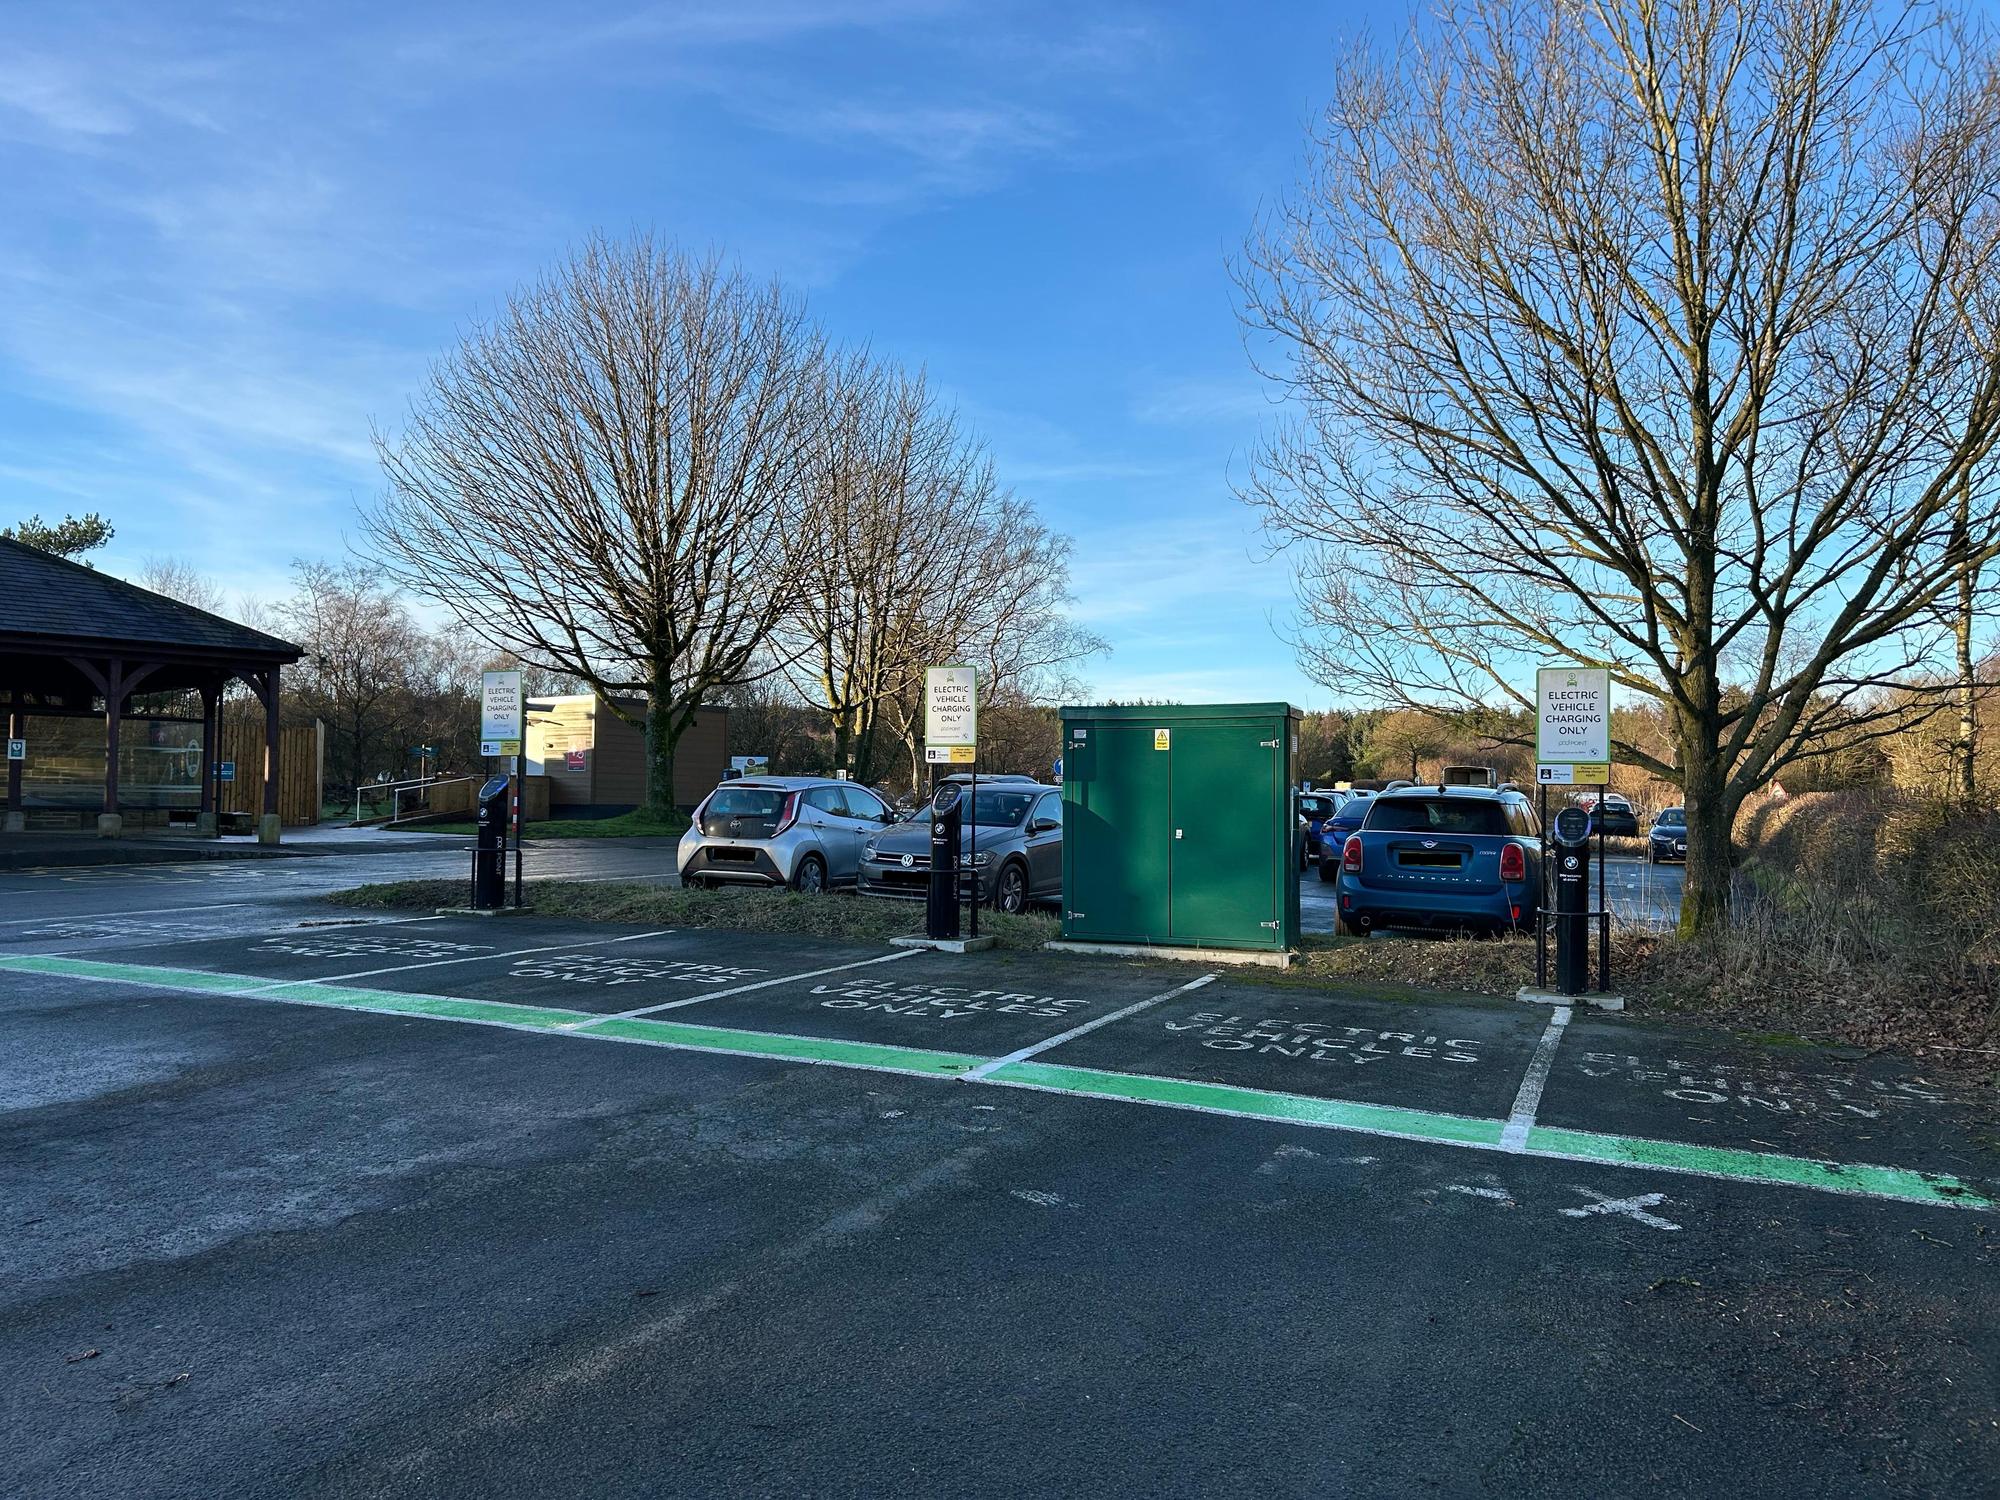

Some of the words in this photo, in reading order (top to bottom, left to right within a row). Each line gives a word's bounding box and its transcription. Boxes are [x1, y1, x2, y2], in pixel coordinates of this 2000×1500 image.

[934, 685, 969, 693] ELECTRIC
[1548, 691, 1598, 700] ELECTRIC
[1551, 703, 1595, 711] VEHICLE
[1545, 715, 1601, 723] CHARGING
[1559, 726, 1588, 735] ONLY
[262, 937, 455, 958] VCLES
[311, 934, 496, 951] CTRIC
[512, 959, 736, 983] VEHICLES
[553, 954, 769, 976] ELECTRIC
[508, 969, 646, 985] ONLY
[810, 985, 1067, 1017] VEHICLES
[843, 979, 1090, 1008] ELECTRIC
[820, 1000, 976, 1018] ONLY
[1188, 1012, 1485, 1049] ELECTRIC
[1165, 1021, 1479, 1063] VEHICLES
[1202, 1038, 1385, 1064] ONLY
